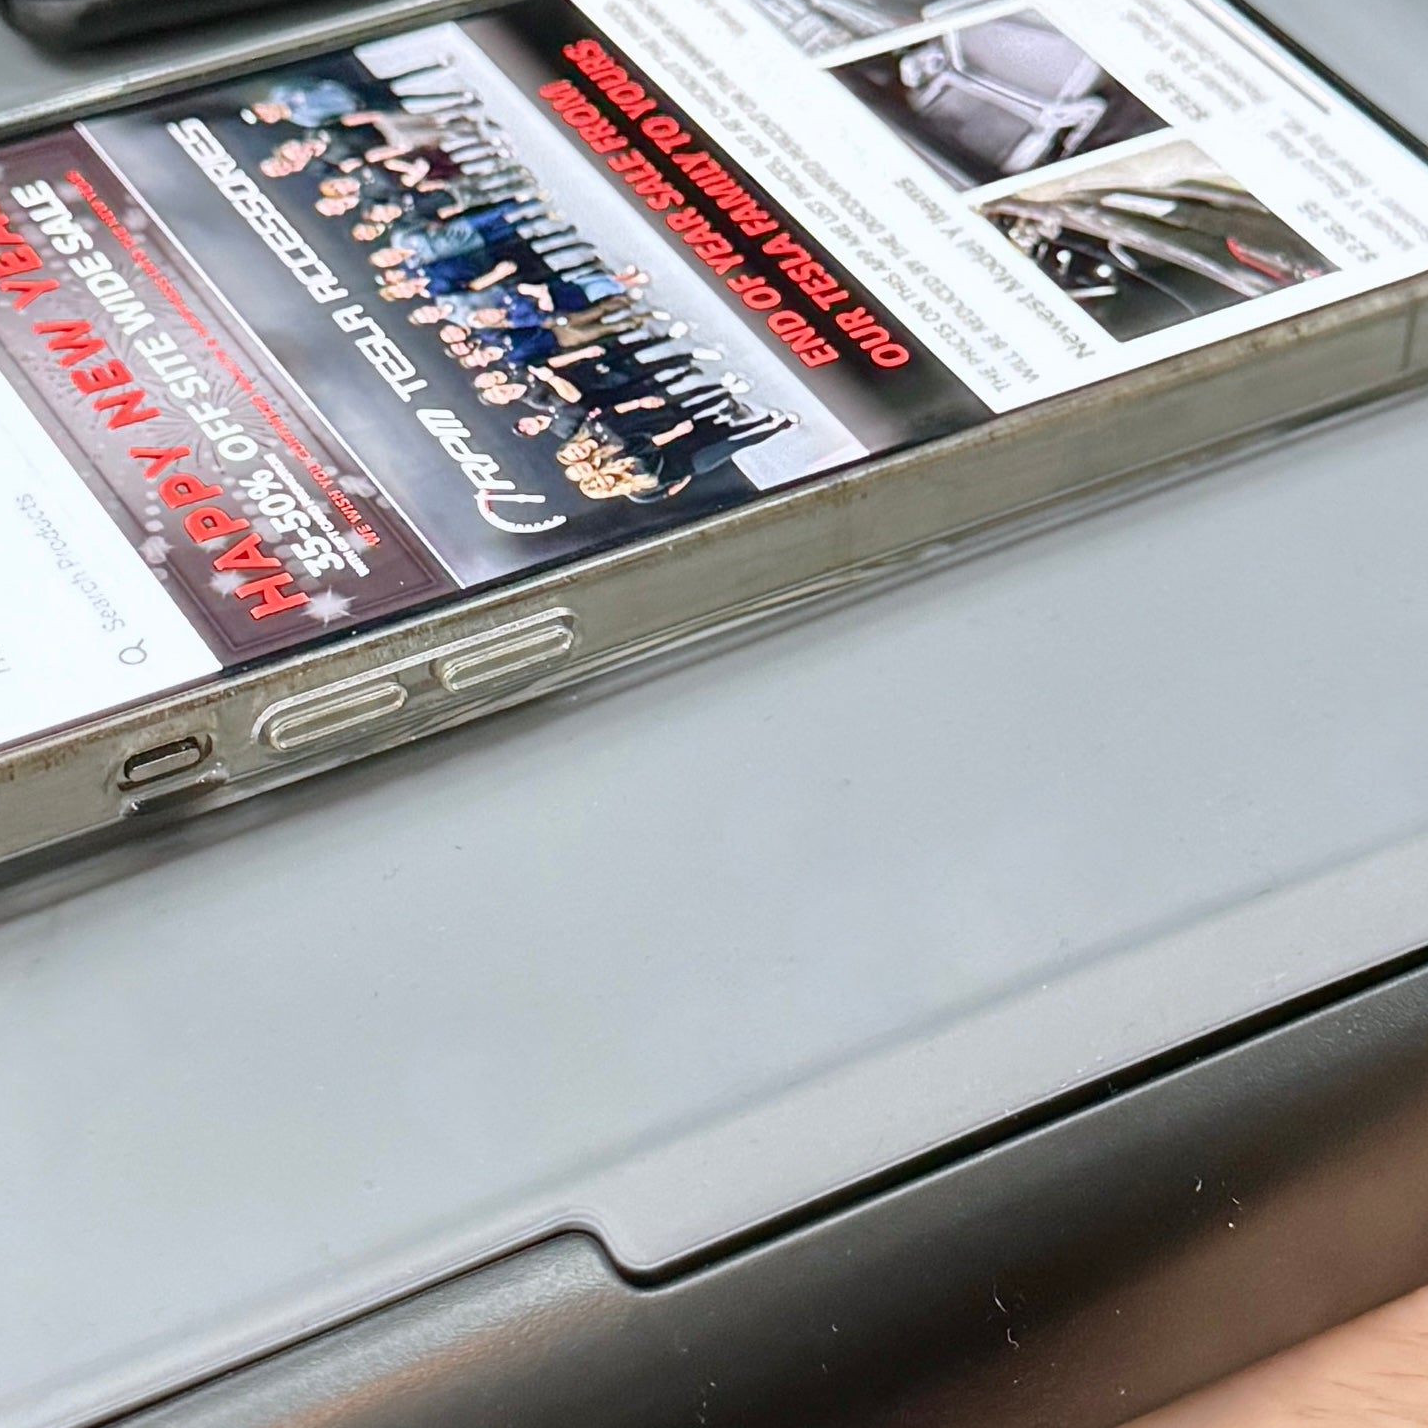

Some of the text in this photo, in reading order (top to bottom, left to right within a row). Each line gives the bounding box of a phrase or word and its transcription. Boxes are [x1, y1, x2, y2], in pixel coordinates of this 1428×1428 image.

[532, 77, 843, 368] END OF YEAR SALE FROM
[555, 36, 917, 370] OUR TESLA FAMILY TO YOURS
[828, 223, 865, 248] ARE
[853, 248, 892, 274] APP
[888, 177, 1097, 360] Newest Model Y Items
[162, 115, 515, 497] RPM TESLA ACCESSORIES
[878, 272, 920, 301] THIS
[917, 274, 991, 333] REDUCED
[908, 300, 944, 323] ON
[931, 321, 988, 366] PRICES
[979, 333, 1009, 351] BE
[6, 178, 348, 578] 35-50% OFF SITE WIDE SALE
[28, 310, 164, 431] NEW
[975, 365, 1015, 392] THE
[997, 350, 1043, 383] WILL
[304, 461, 336, 488] YOU
[325, 488, 364, 523] WISH
[124, 432, 312, 622] HAPPY
[353, 523, 383, 546] WE
[8, 491, 127, 633] Search Products
